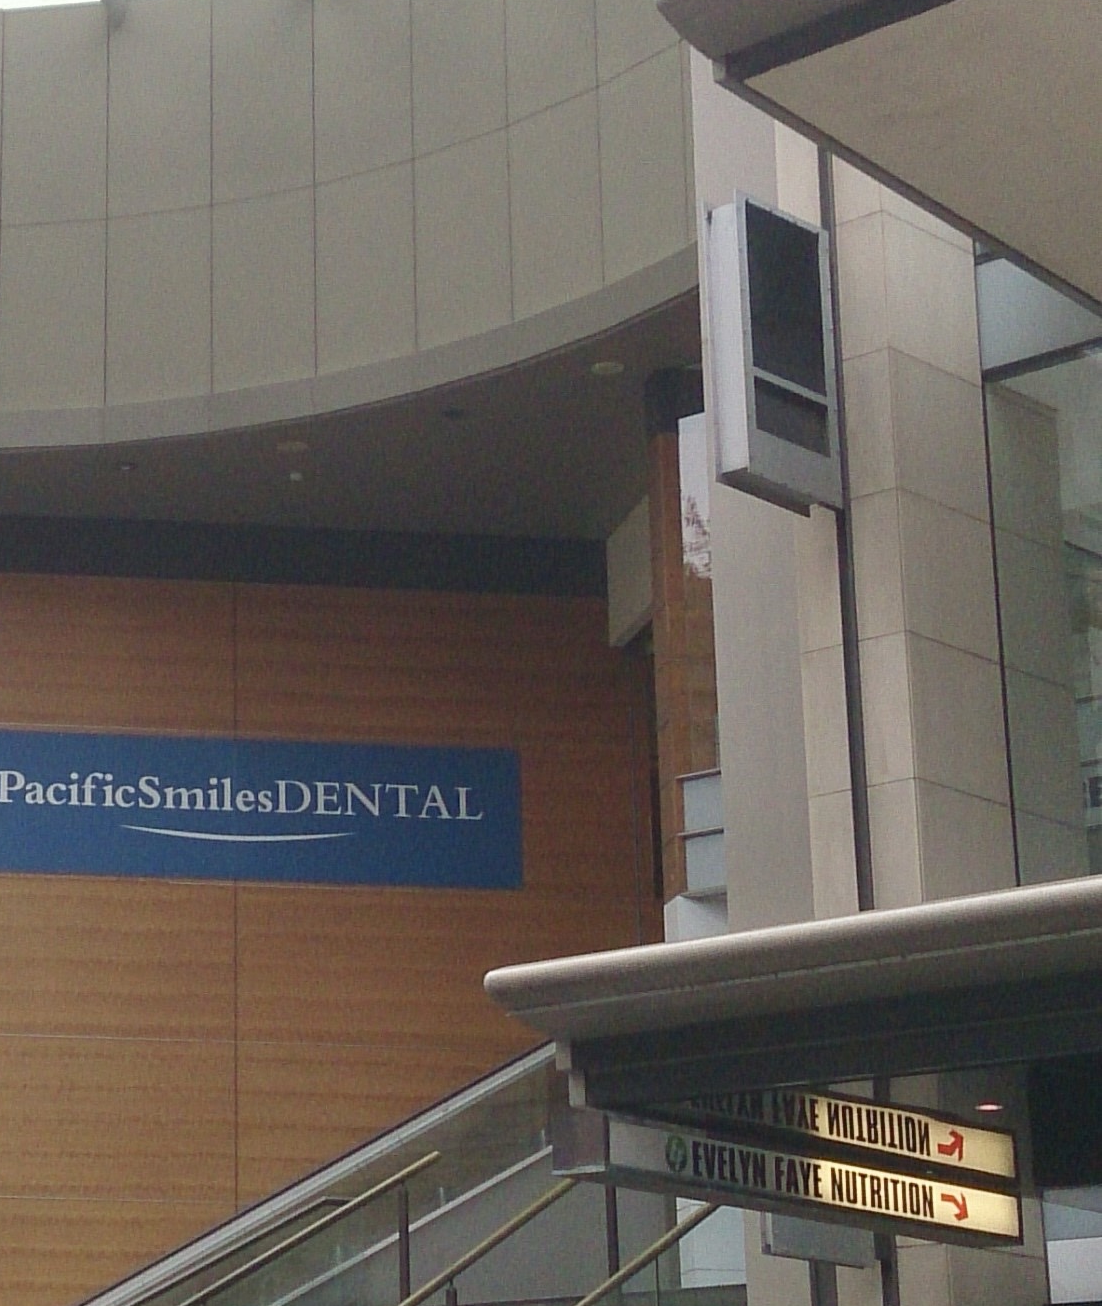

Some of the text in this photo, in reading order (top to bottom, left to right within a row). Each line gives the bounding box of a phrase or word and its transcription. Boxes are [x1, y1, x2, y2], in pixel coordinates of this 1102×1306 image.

[691, 1140, 935, 1219] EVELYN FAYE NUTRITION
